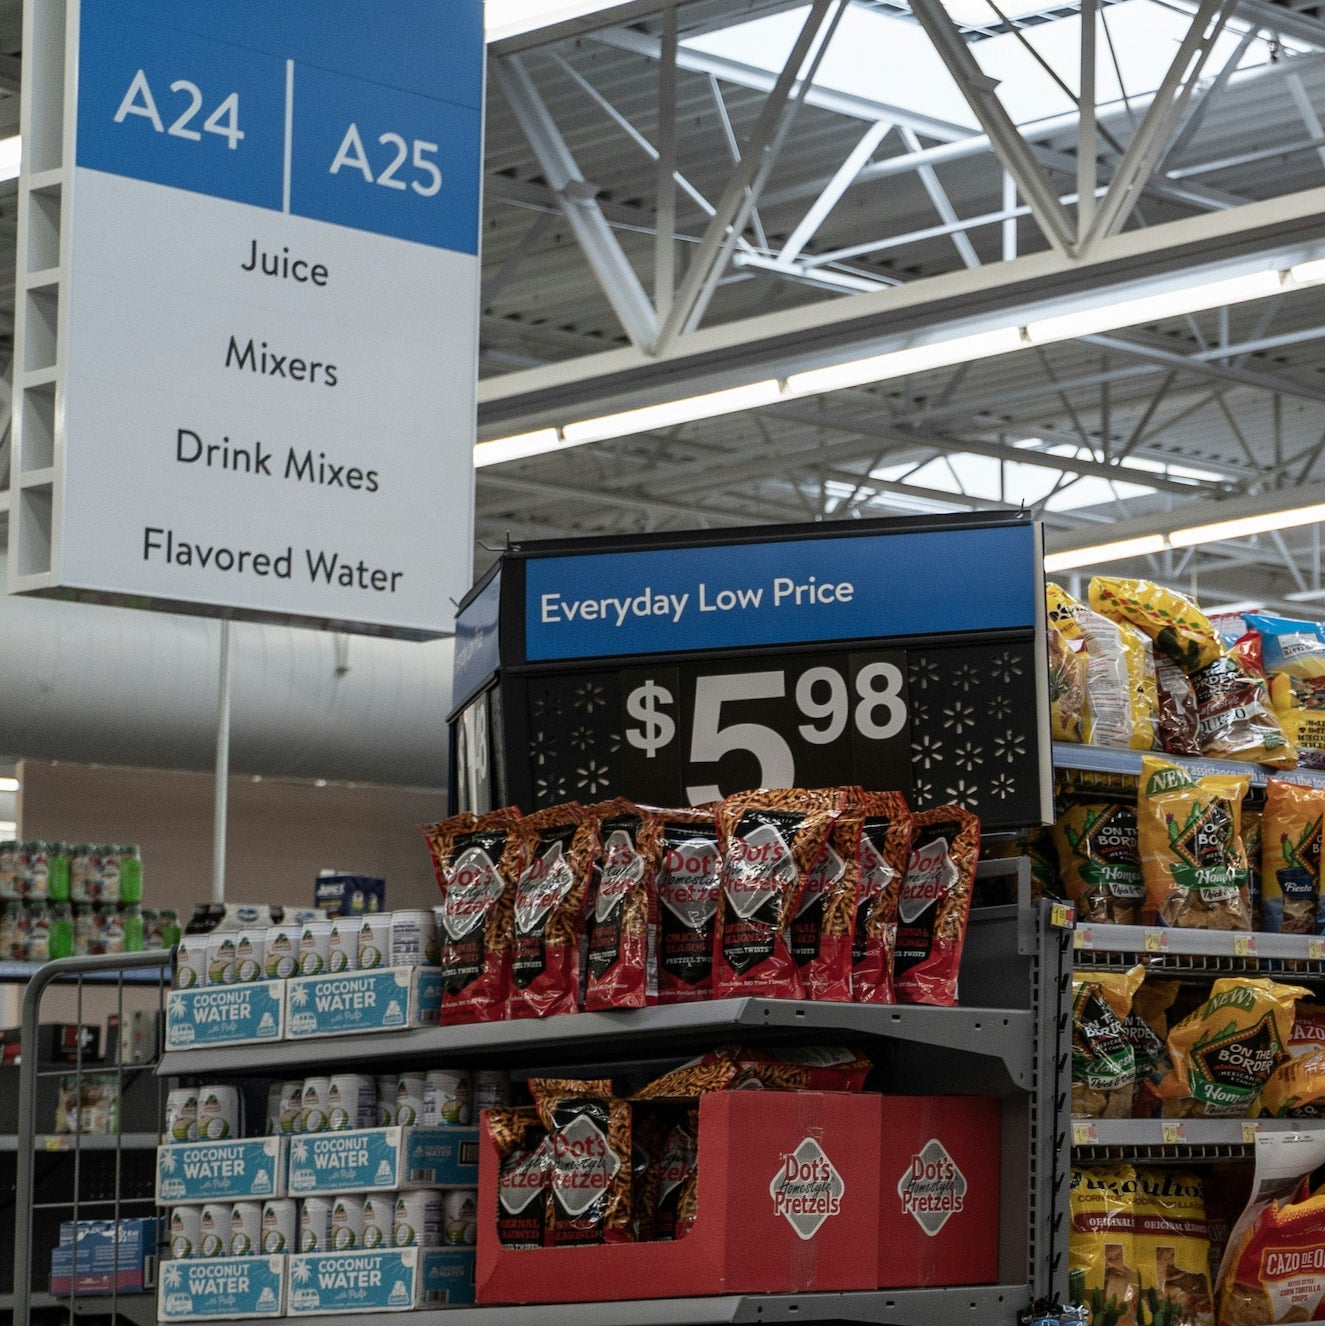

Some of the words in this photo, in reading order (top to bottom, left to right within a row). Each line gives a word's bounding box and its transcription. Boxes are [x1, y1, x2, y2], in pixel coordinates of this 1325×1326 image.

[113, 69, 245, 150] A24
[329, 123, 443, 198] A25
[241, 240, 330, 288] Juice
[224, 335, 339, 388] Mixers
[176, 428, 272, 477] Drink
[285, 447, 380, 493] Mixes
[143, 528, 293, 580] Flavored
[305, 550, 404, 594] Water
[540, 586, 689, 626] Everyday
[698, 583, 763, 613] Low
[773, 576, 855, 606] Price
[1298, 774, 1311, 785] the
[1102, 827, 1120, 836] ON
[1285, 881, 1312, 893] Fiesta
[315, 978, 375, 997] COCONUT
[315, 991, 376, 1013] WATER
[1209, 988, 1253, 1010] NEW!
[1218, 1051, 1274, 1075] BORDER
[1229, 1044, 1251, 1058] ON
[1256, 1049, 1274, 1062] THE
[314, 1137, 368, 1154] COCONUT
[314, 1150, 369, 1170] WATER
[785, 1154, 831, 1181] Dot's
[912, 1154, 955, 1181] Dot's
[780, 1180, 832, 1197] Homestyle
[907, 1179, 956, 1196] Homestyle
[774, 1191, 840, 1216] Pretzels
[902, 1190, 964, 1213] Pretzels
[1144, 1220, 1183, 1231] ORIGINAL
[318, 1257, 381, 1274] COCONUT
[1266, 1253, 1300, 1275] CAZO
[1302, 1251, 1314, 1267] DE
[318, 1270, 381, 1290] WATER
